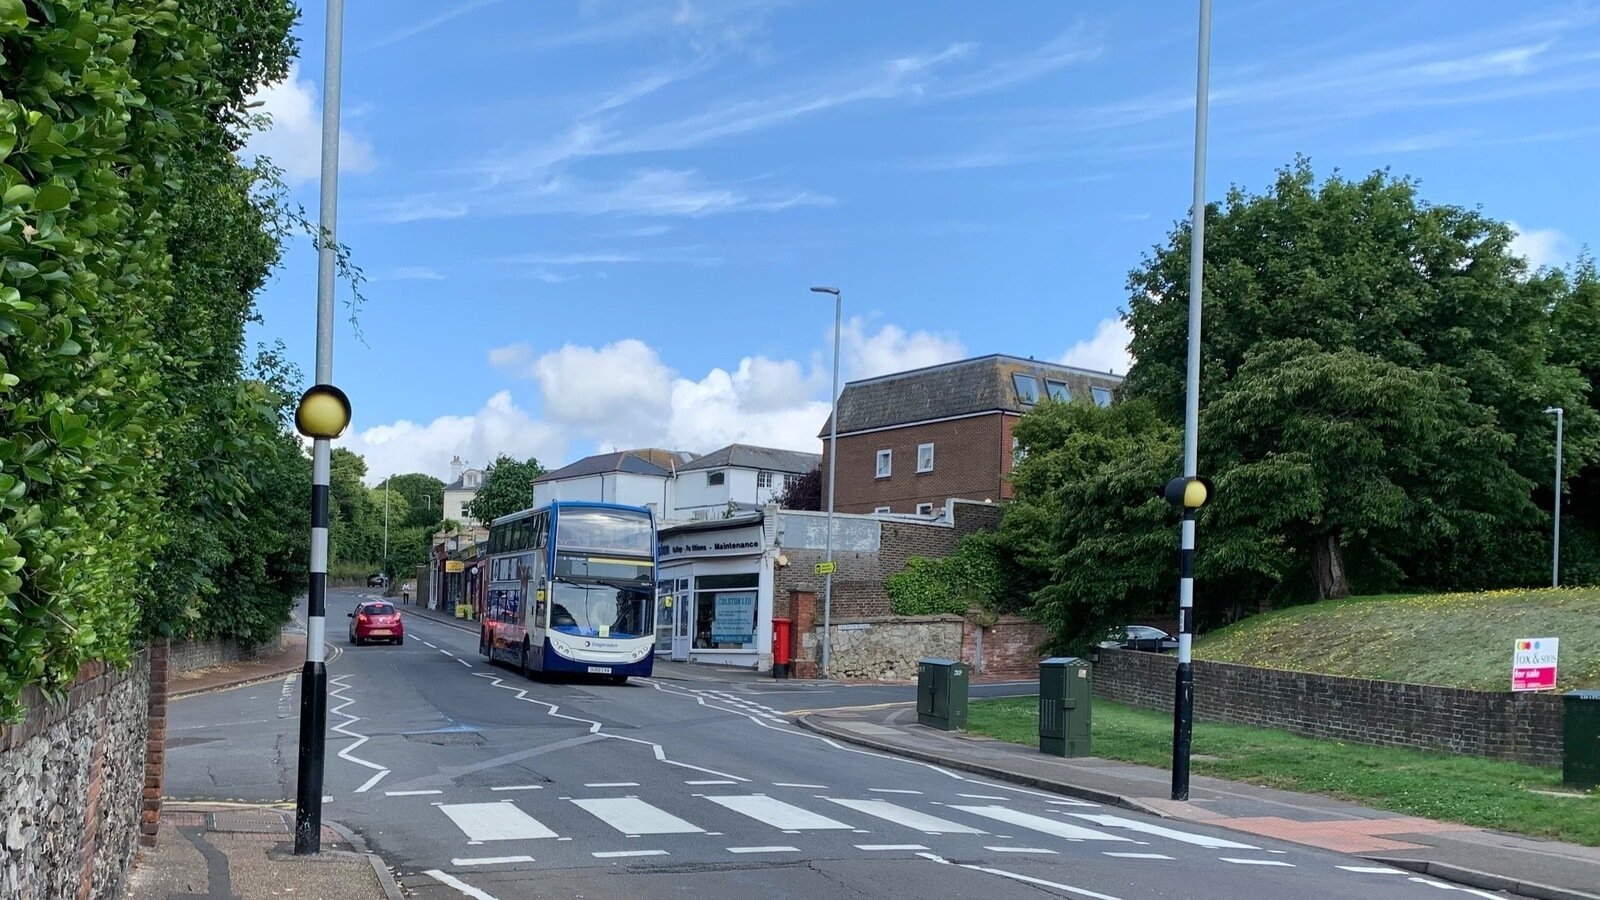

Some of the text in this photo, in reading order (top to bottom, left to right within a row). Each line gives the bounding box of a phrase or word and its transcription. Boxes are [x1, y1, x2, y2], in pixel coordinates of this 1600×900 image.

[714, 541, 759, 550] Maintenance
[1516, 652, 1557, 665] fox & sons
[1514, 669, 1541, 679] for sale
